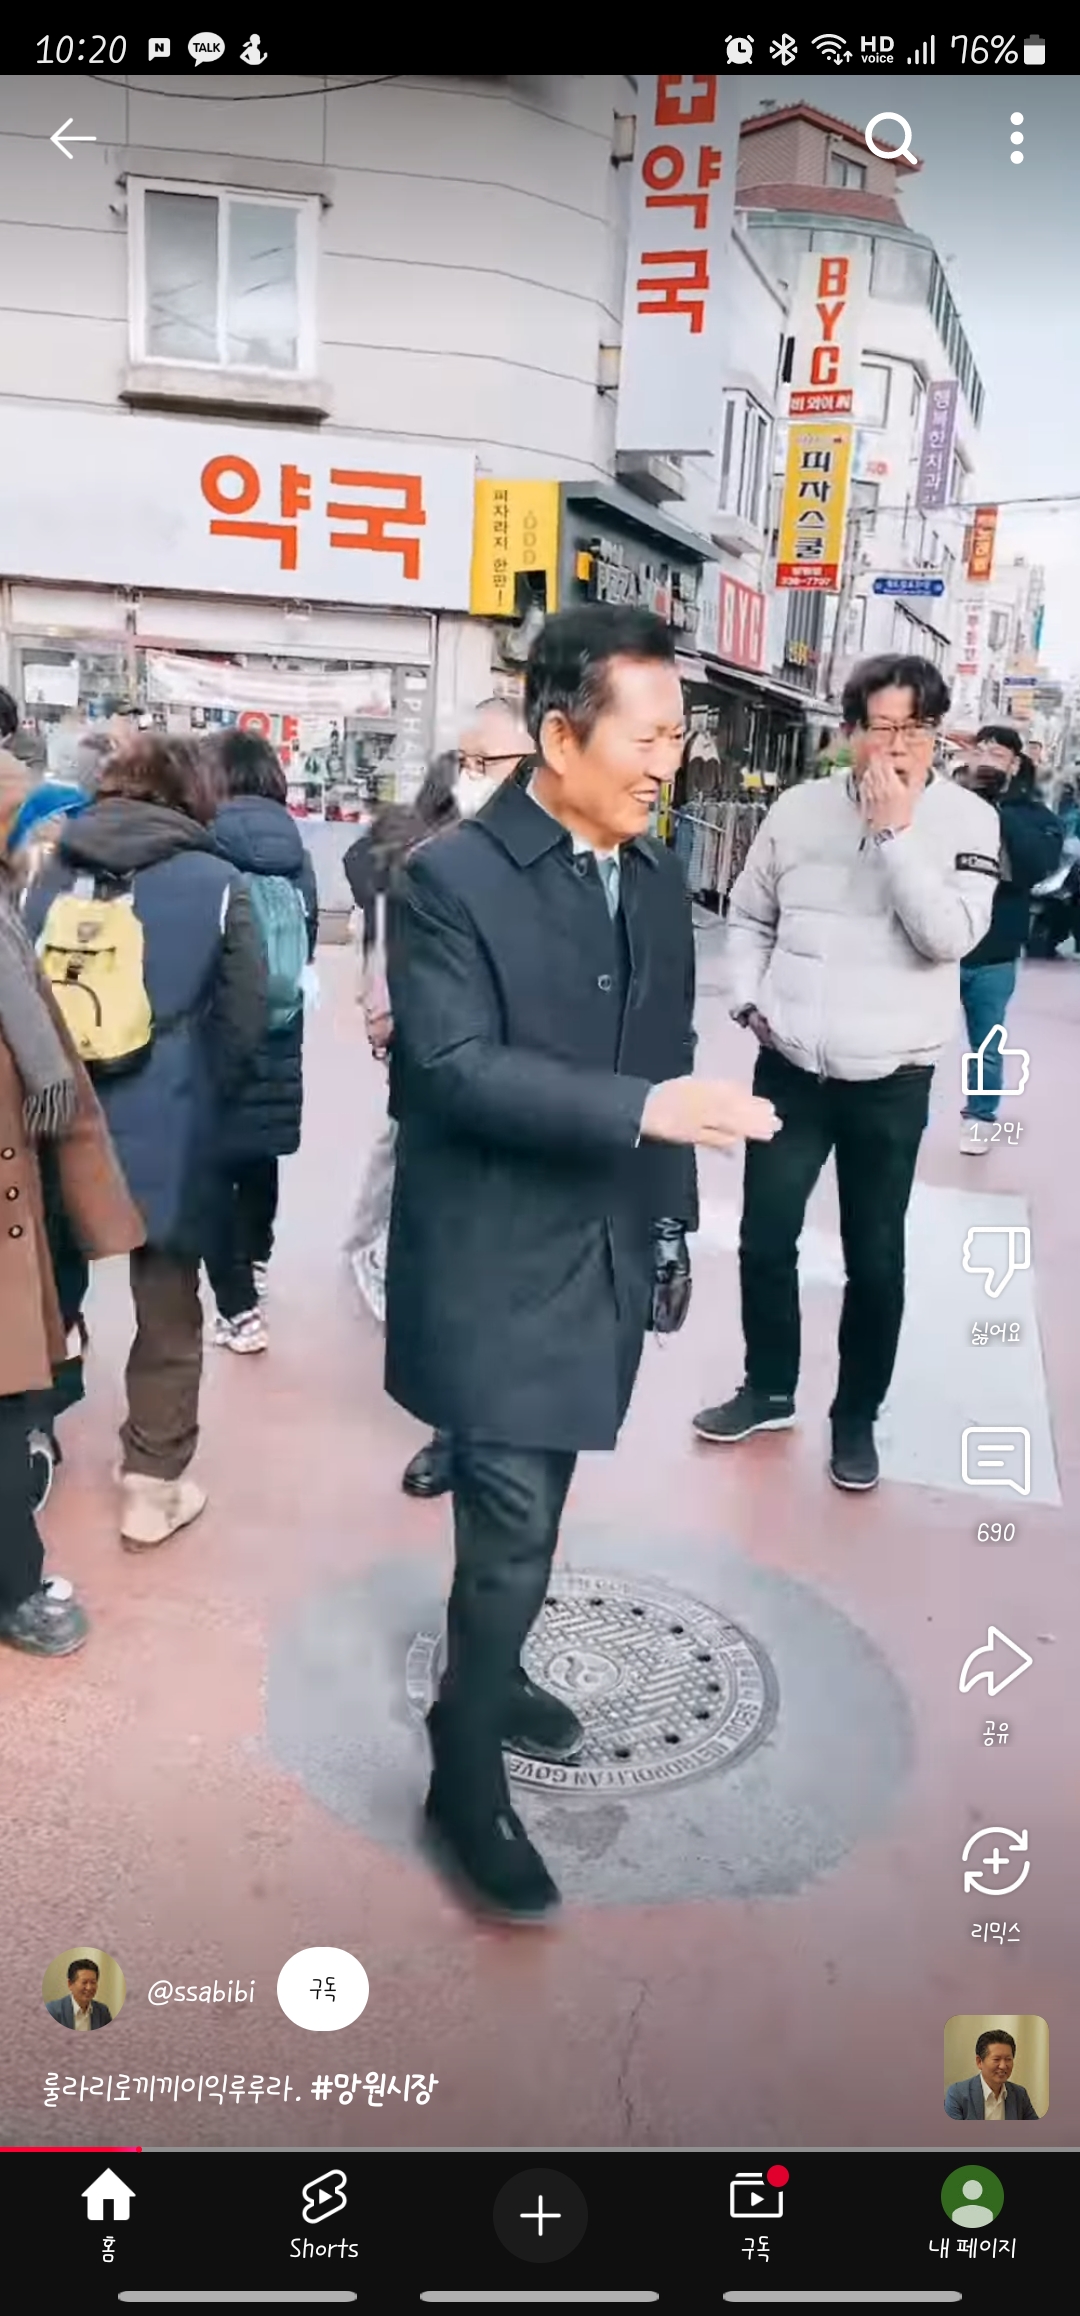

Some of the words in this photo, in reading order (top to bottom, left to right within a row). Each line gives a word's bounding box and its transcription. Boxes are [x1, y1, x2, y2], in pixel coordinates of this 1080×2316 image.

[639, 147, 721, 333] 약국
[811, 258, 848, 385] BYC
[200, 455, 426, 580] 약국
[796, 451, 831, 559] 피자스쿨
[722, 581, 762, 663] BYC
[509, 1757, 568, 1784] GOVE
